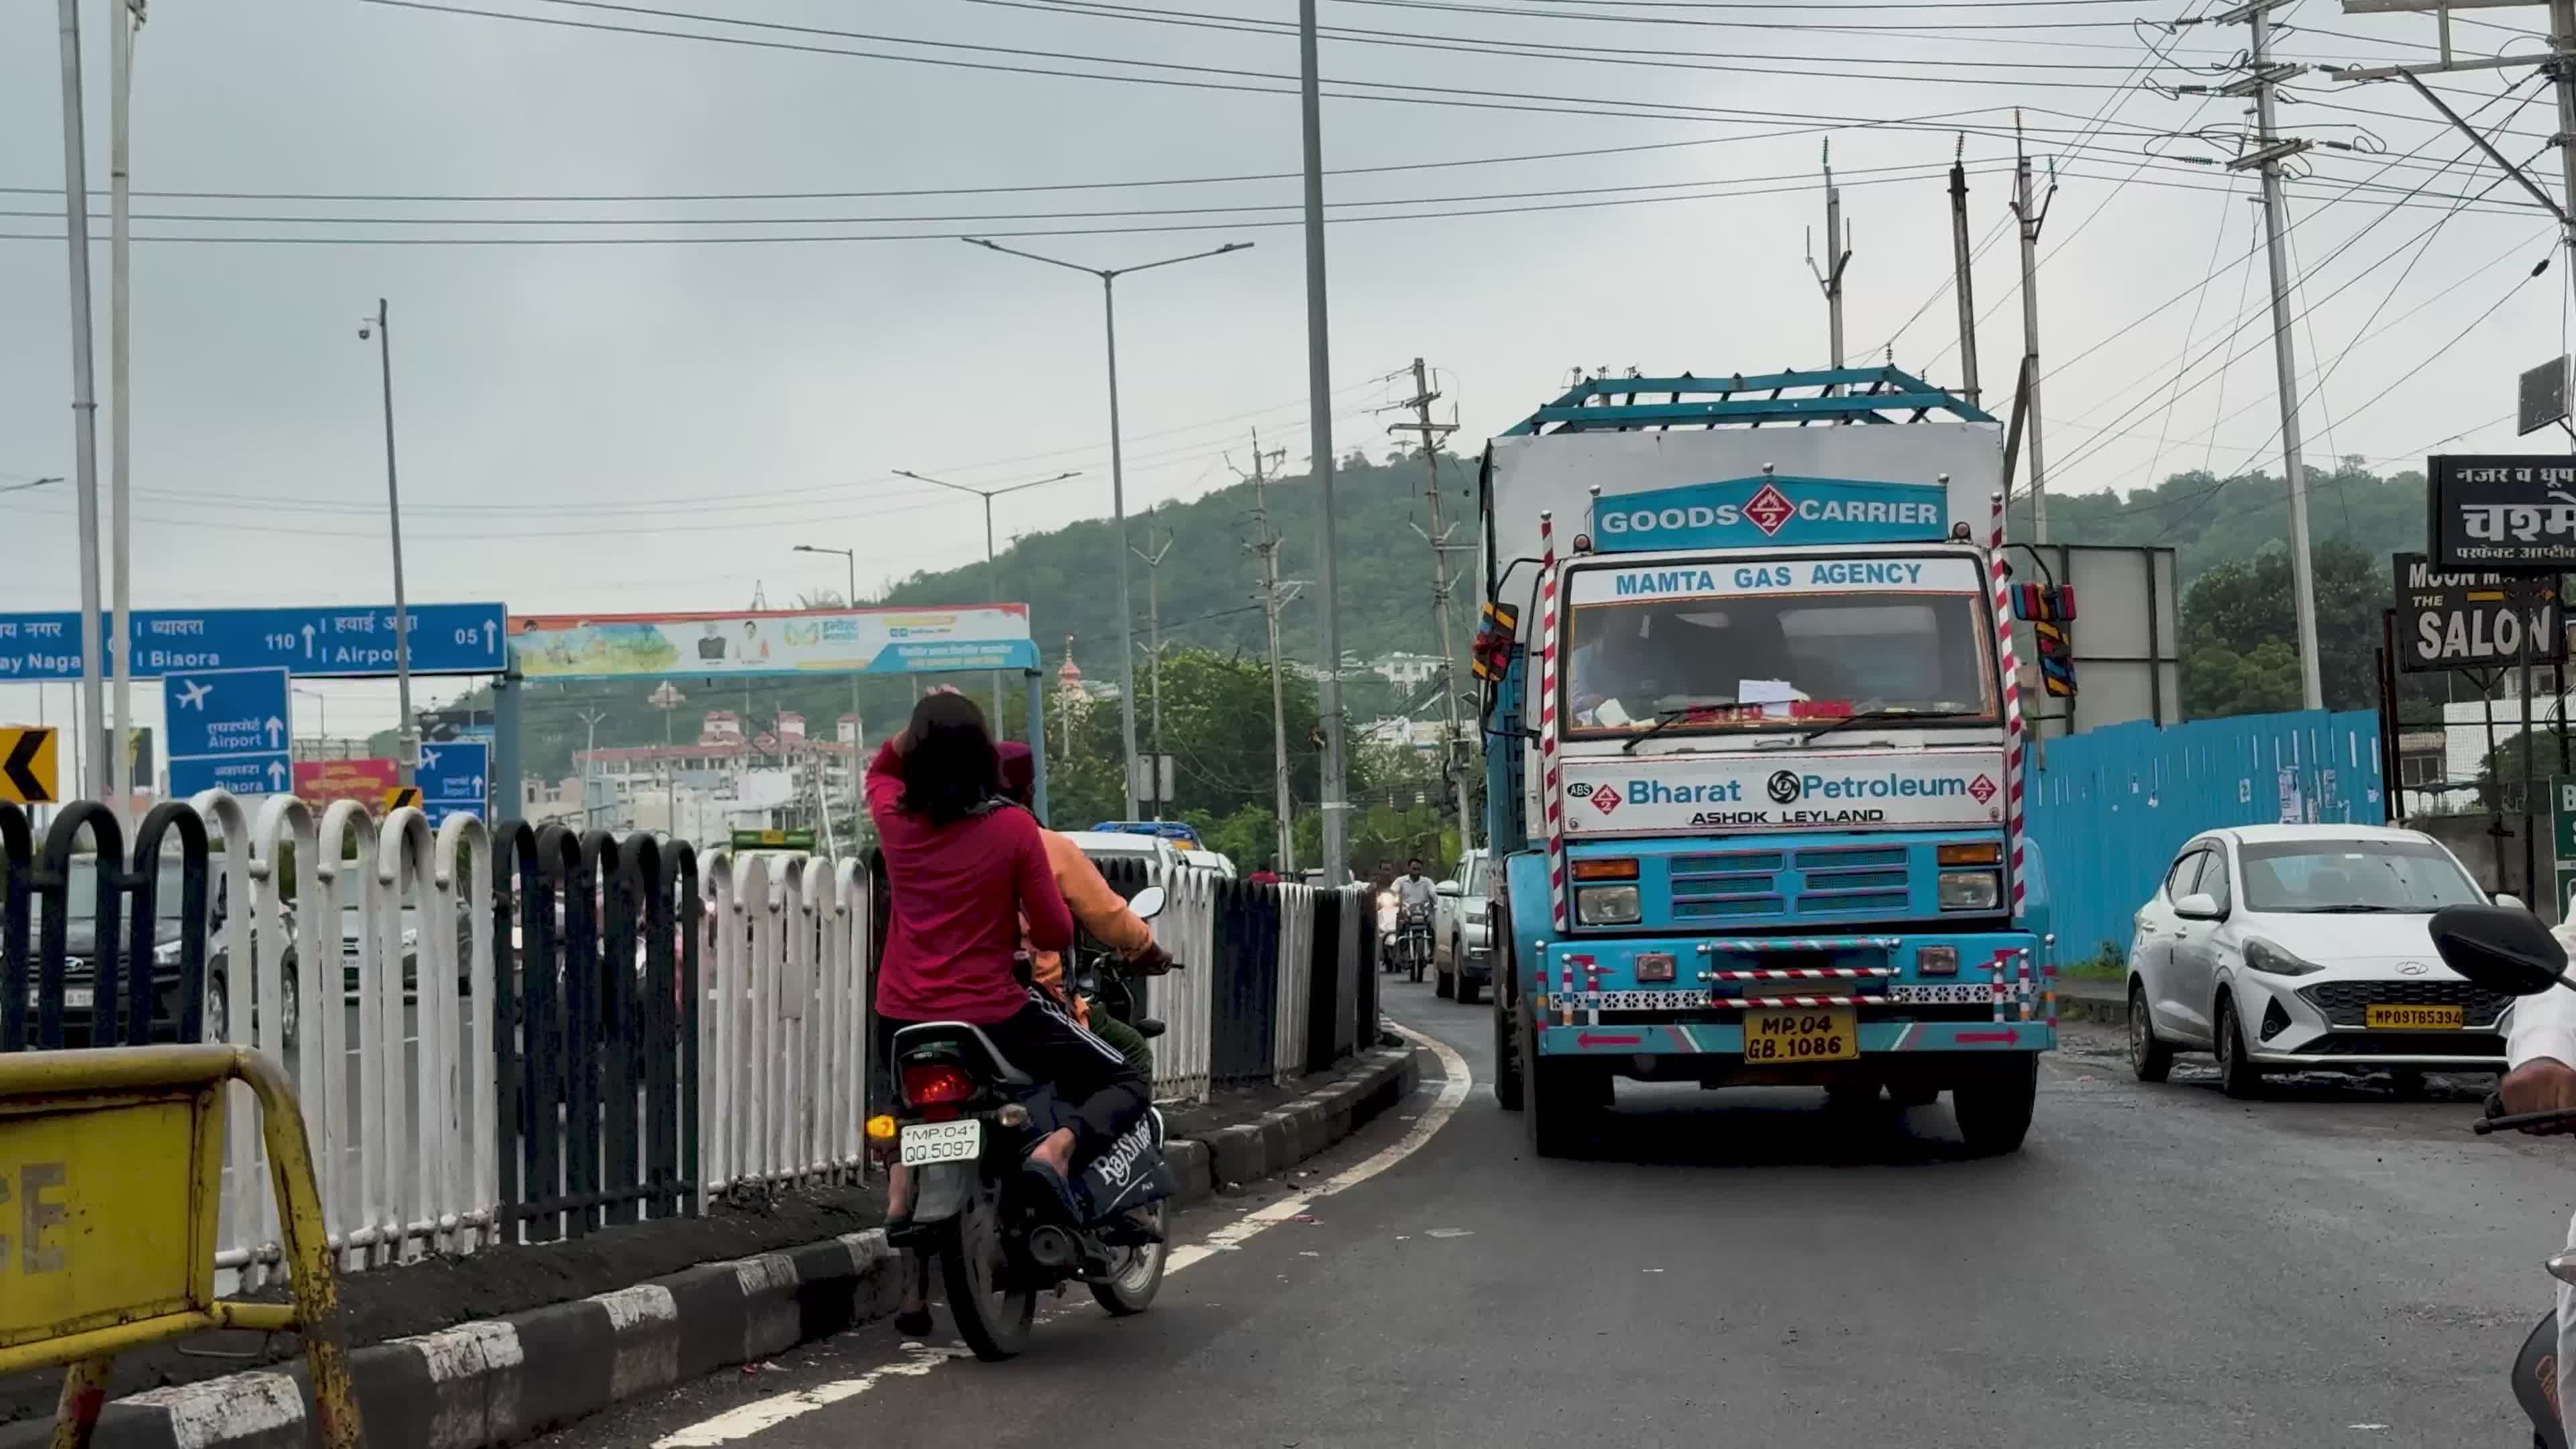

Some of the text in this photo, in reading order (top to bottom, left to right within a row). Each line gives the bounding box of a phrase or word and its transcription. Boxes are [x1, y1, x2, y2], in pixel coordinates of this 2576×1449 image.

[1602, 504, 1740, 534] GOODS
[1799, 499, 1938, 525] CARRIER
[1616, 564, 1922, 595] MAMTA GAS AGENCY
[2412, 595, 2444, 607] THE
[454, 629, 478, 645] 05
[2417, 606, 2551, 659] SALON
[265, 633, 295, 650] 110
[151, 650, 220, 667] Biaora
[209, 735, 262, 749] Airport
[1570, 785, 1591, 795] ABS
[1628, 773, 1965, 805] Bharat Petroleum
[1691, 809, 1884, 824] ASHOK LEYLAND
[912, 1126, 967, 1140] MP.04
[906, 1140, 975, 1162] QQ.5097
[0, 1164, 65, 1275] E
